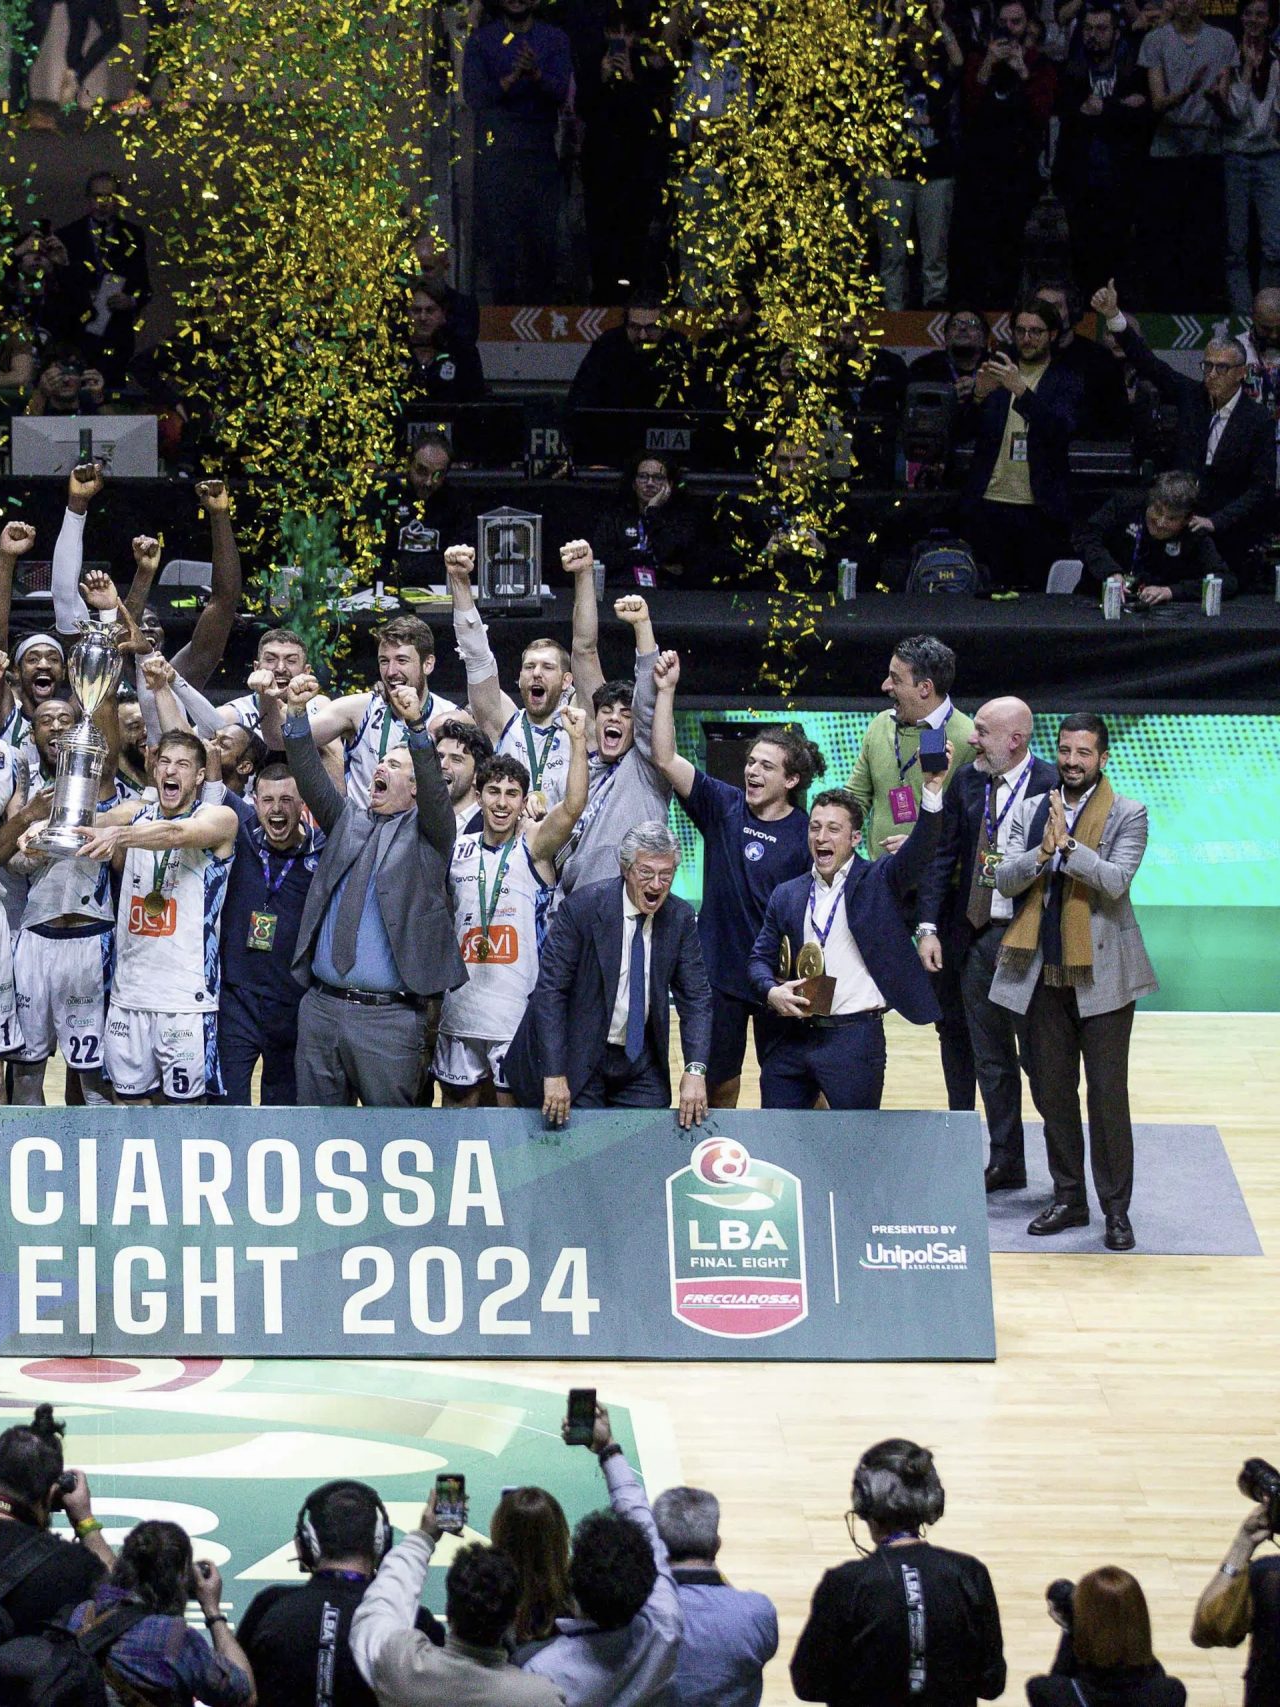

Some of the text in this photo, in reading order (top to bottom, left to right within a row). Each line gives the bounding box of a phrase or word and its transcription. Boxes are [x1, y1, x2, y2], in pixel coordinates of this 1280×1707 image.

[743, 827, 777, 843] GIVOVA
[0, 1018, 11, 1046] 1
[70, 1035, 99, 1063] 22
[173, 1067, 190, 1094] 5
[688, 1219, 788, 1251] LBA
[871, 1225, 957, 1235] PRESENTED BY
[690, 1256, 789, 1268] FINAL EIGHT
[865, 1243, 967, 1270] UnipolSai
[19, 1245, 298, 1335] EIGHT
[341, 1245, 601, 1336] 2024
[683, 1293, 800, 1305] FRECCIAROSSA
